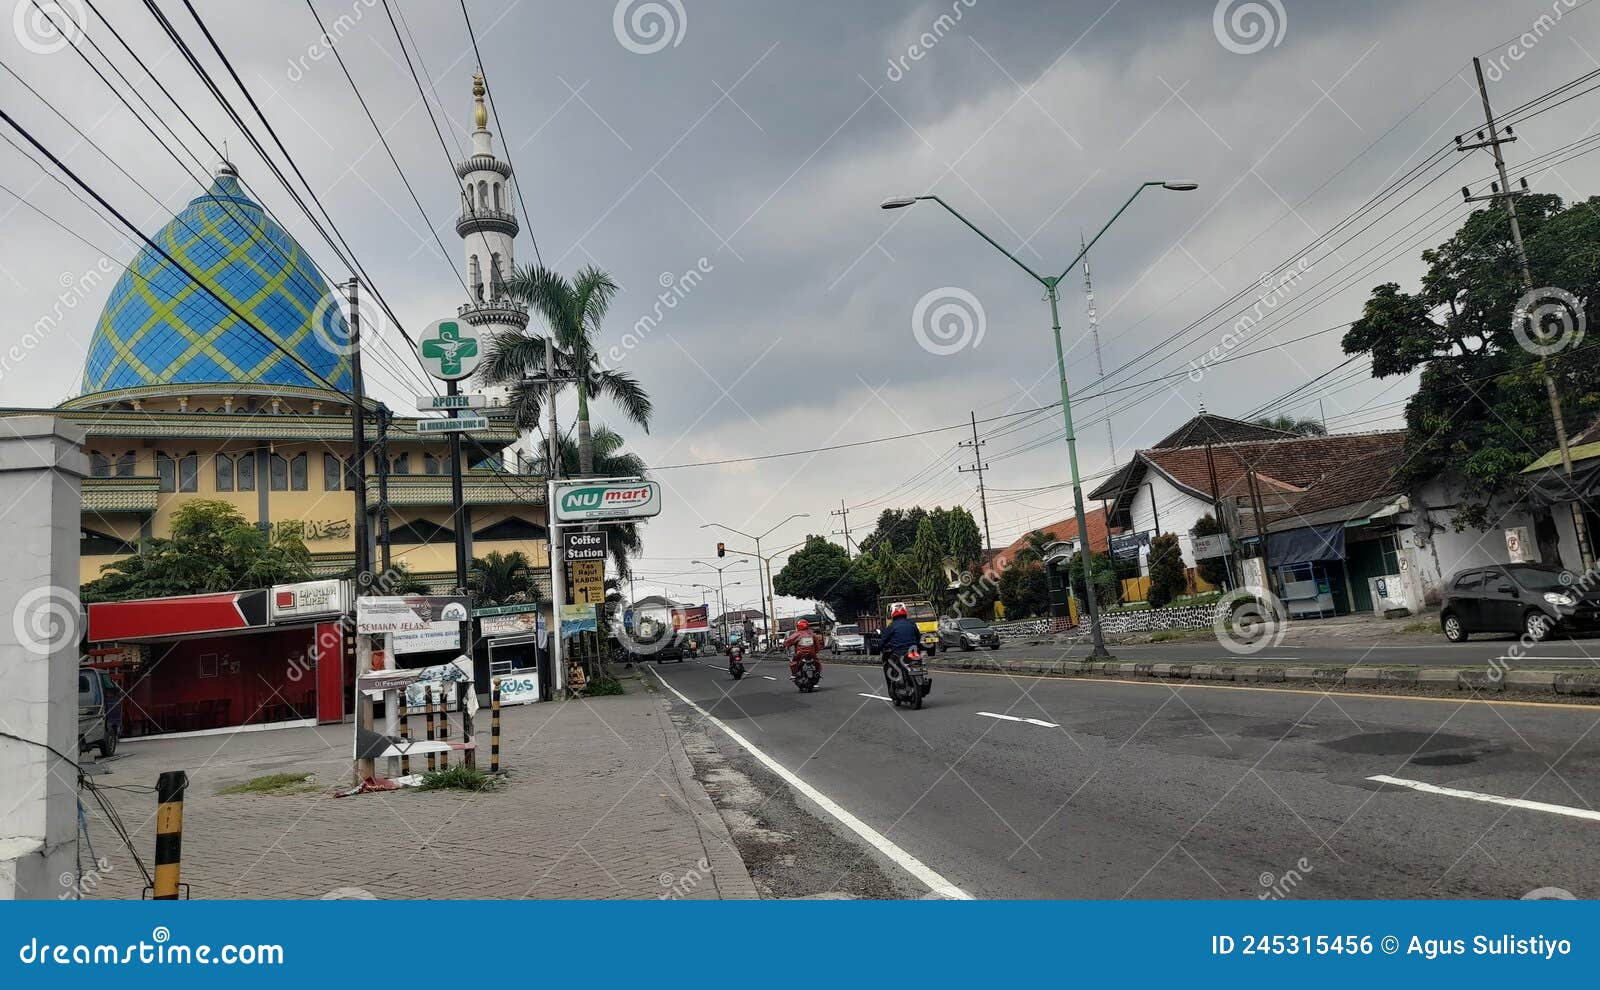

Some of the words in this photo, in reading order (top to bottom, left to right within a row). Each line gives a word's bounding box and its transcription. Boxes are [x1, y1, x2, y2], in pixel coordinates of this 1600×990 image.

[432, 396, 469, 407] APOTEK
[566, 493, 598, 507] NU
[605, 488, 648, 500] mart
[570, 535, 601, 545] Coffee
[568, 548, 604, 559] Station
